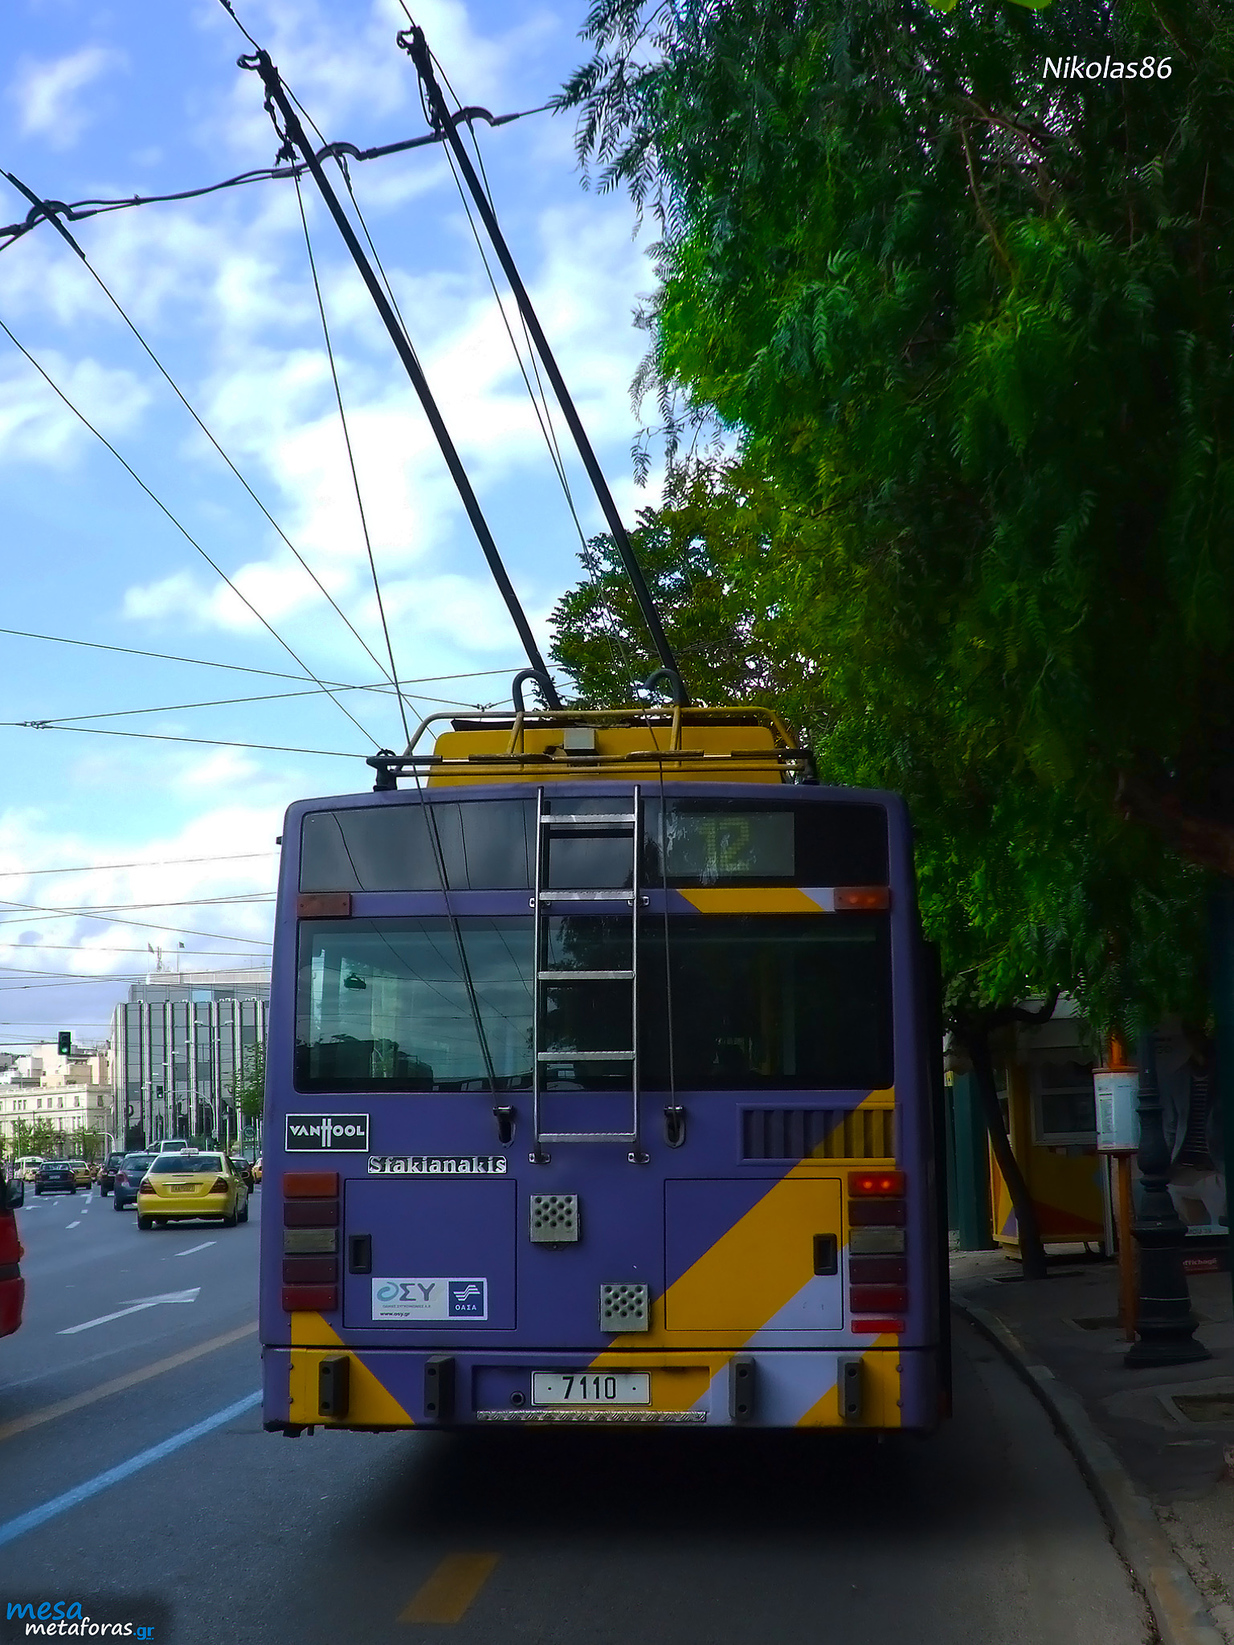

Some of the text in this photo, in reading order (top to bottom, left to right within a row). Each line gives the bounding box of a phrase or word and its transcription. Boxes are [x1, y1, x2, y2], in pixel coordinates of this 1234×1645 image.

[700, 817, 749, 871] 12
[369, 1156, 506, 1173] Sfakianakis
[562, 1376, 616, 1399] 7110
